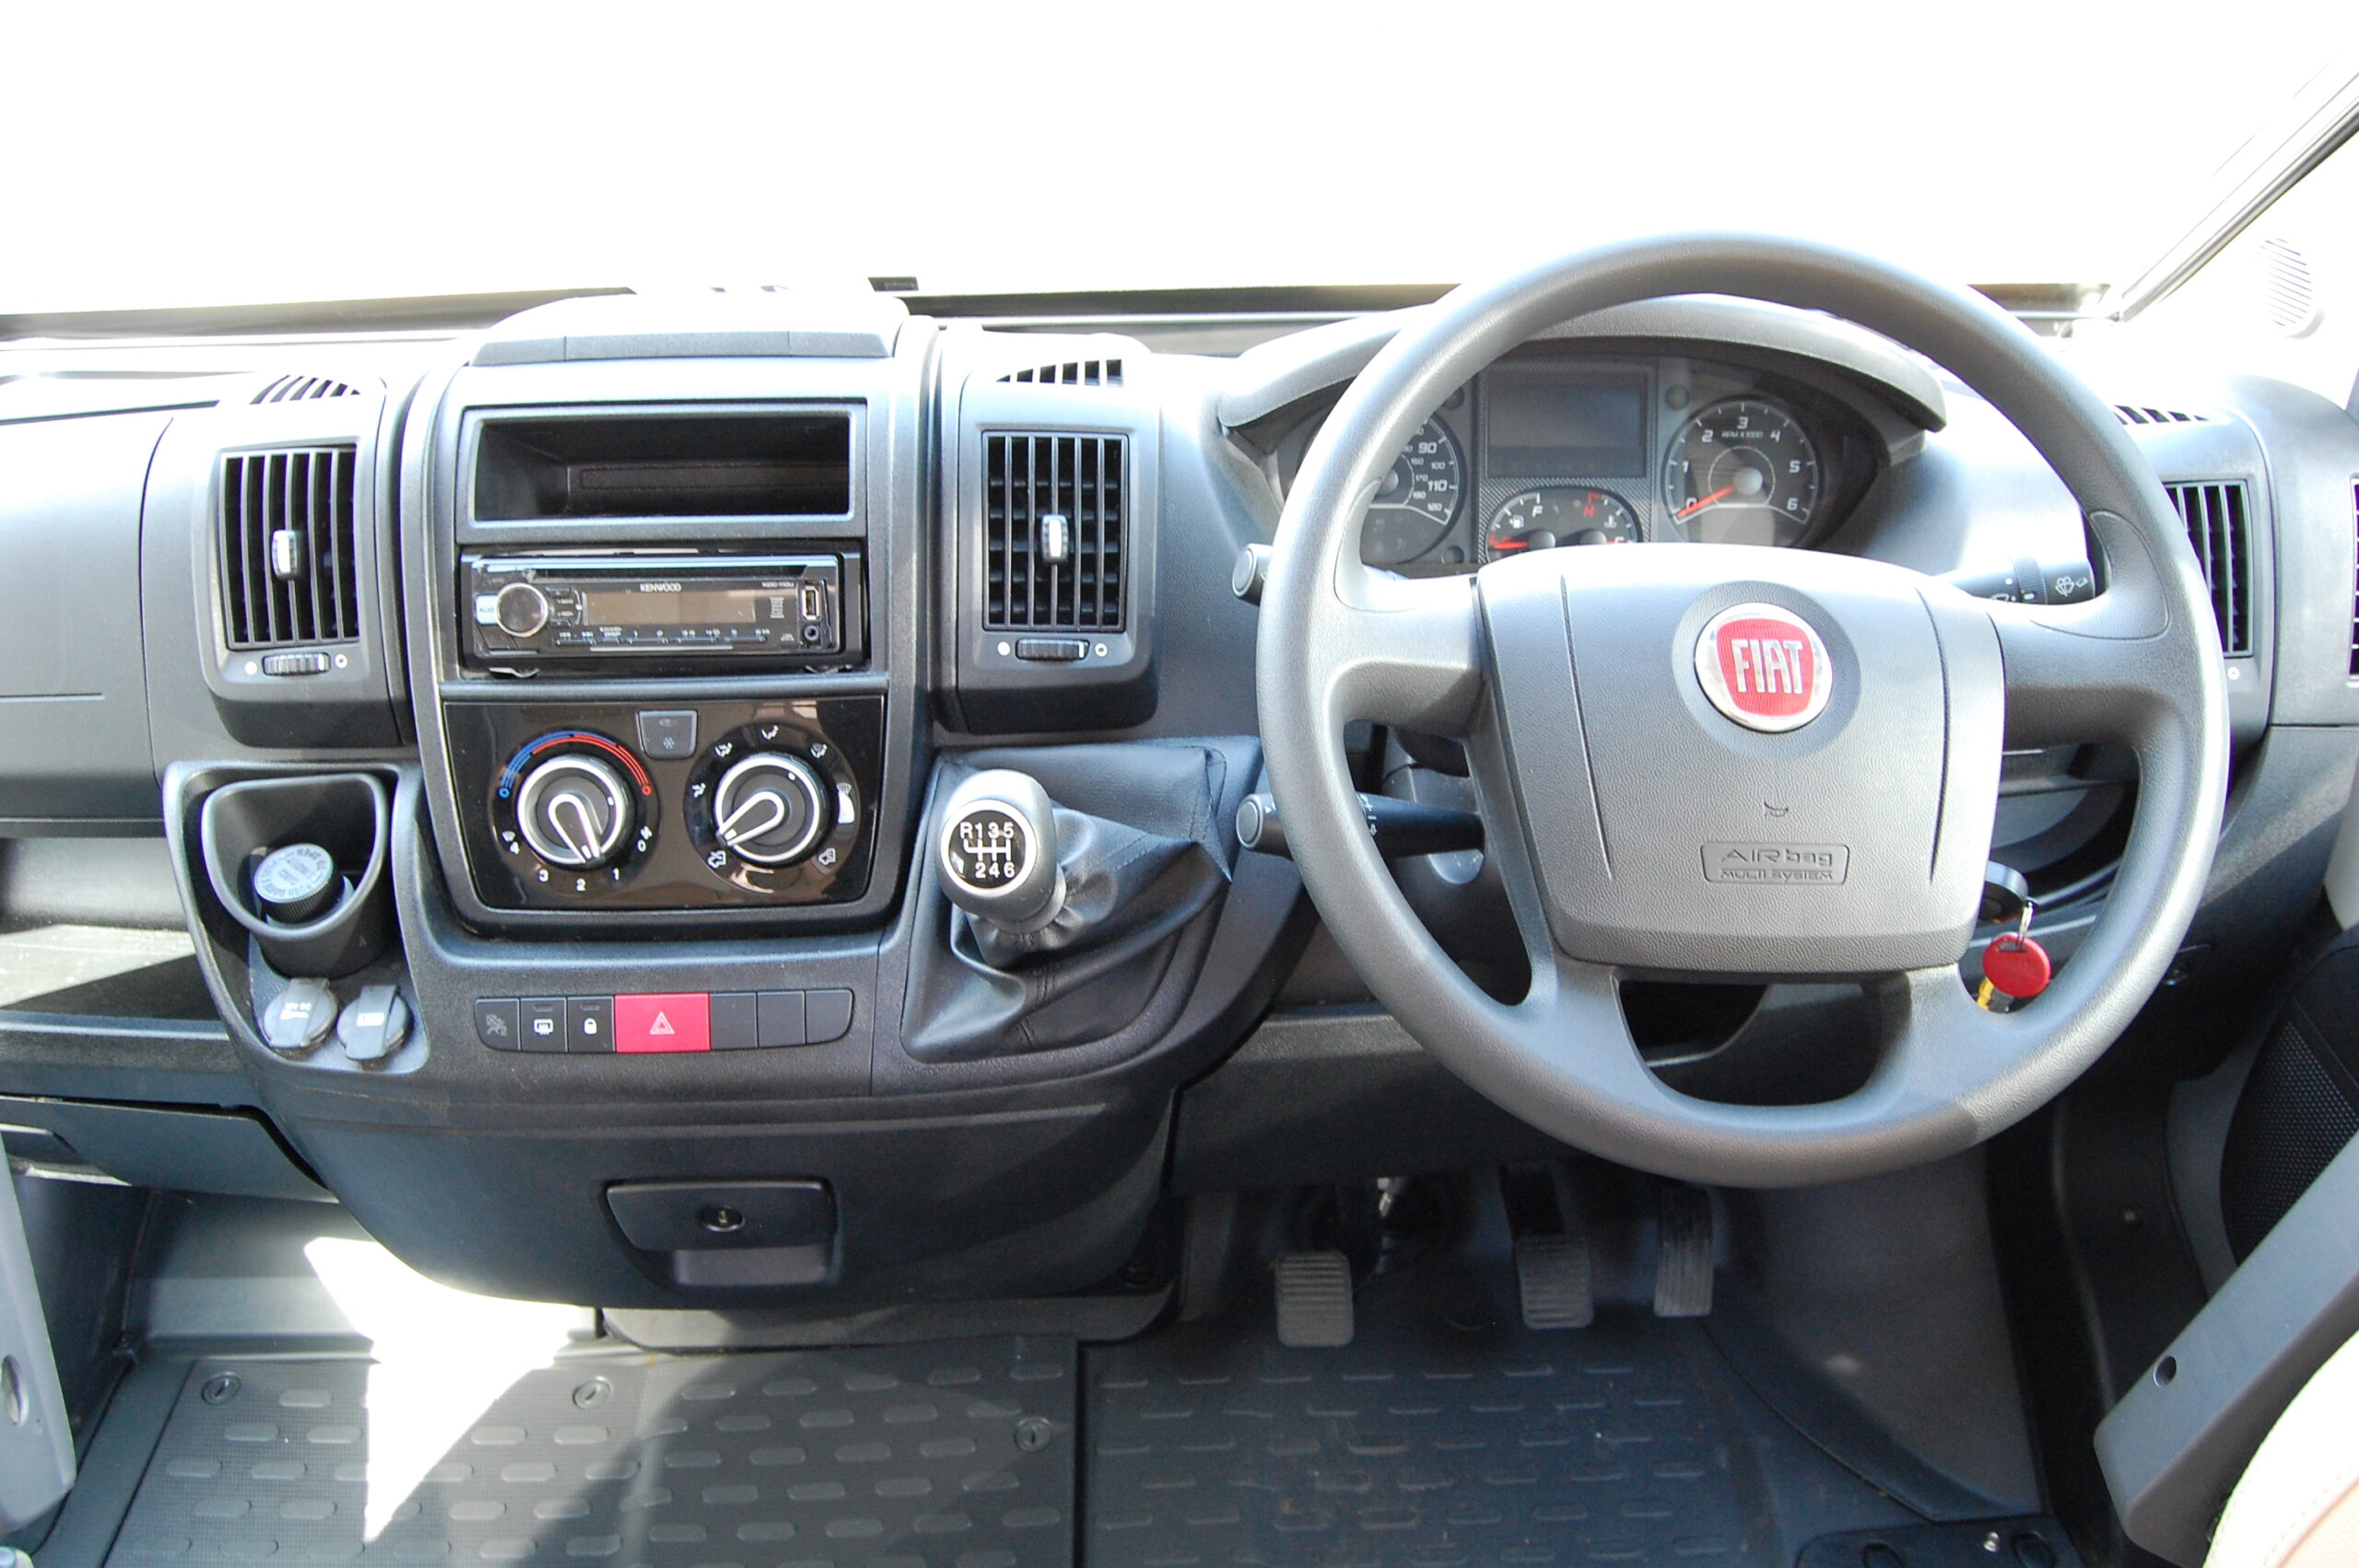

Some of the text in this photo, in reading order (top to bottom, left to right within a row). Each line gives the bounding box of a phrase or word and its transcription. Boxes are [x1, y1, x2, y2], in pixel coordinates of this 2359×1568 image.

[1737, 416, 1748, 429] 3
[1702, 429, 1714, 442] 2
[1769, 430, 1781, 442] 4
[1418, 442, 1438, 453] 90
[1431, 462, 1445, 470] 100
[1682, 461, 1689, 474] 1
[1790, 461, 1801, 474] 5
[1428, 479, 1448, 492] 110
[1787, 497, 1799, 510] 6
[1532, 506, 1543, 518] F
[1583, 507, 1596, 518] H
[640, 582, 682, 591] KENWOOD
[1731, 638, 1803, 695] FIAT
[510, 841, 520, 855] 4
[538, 869, 549, 882] 3
[613, 868, 620, 881] 1
[576, 878, 586, 892] 2
